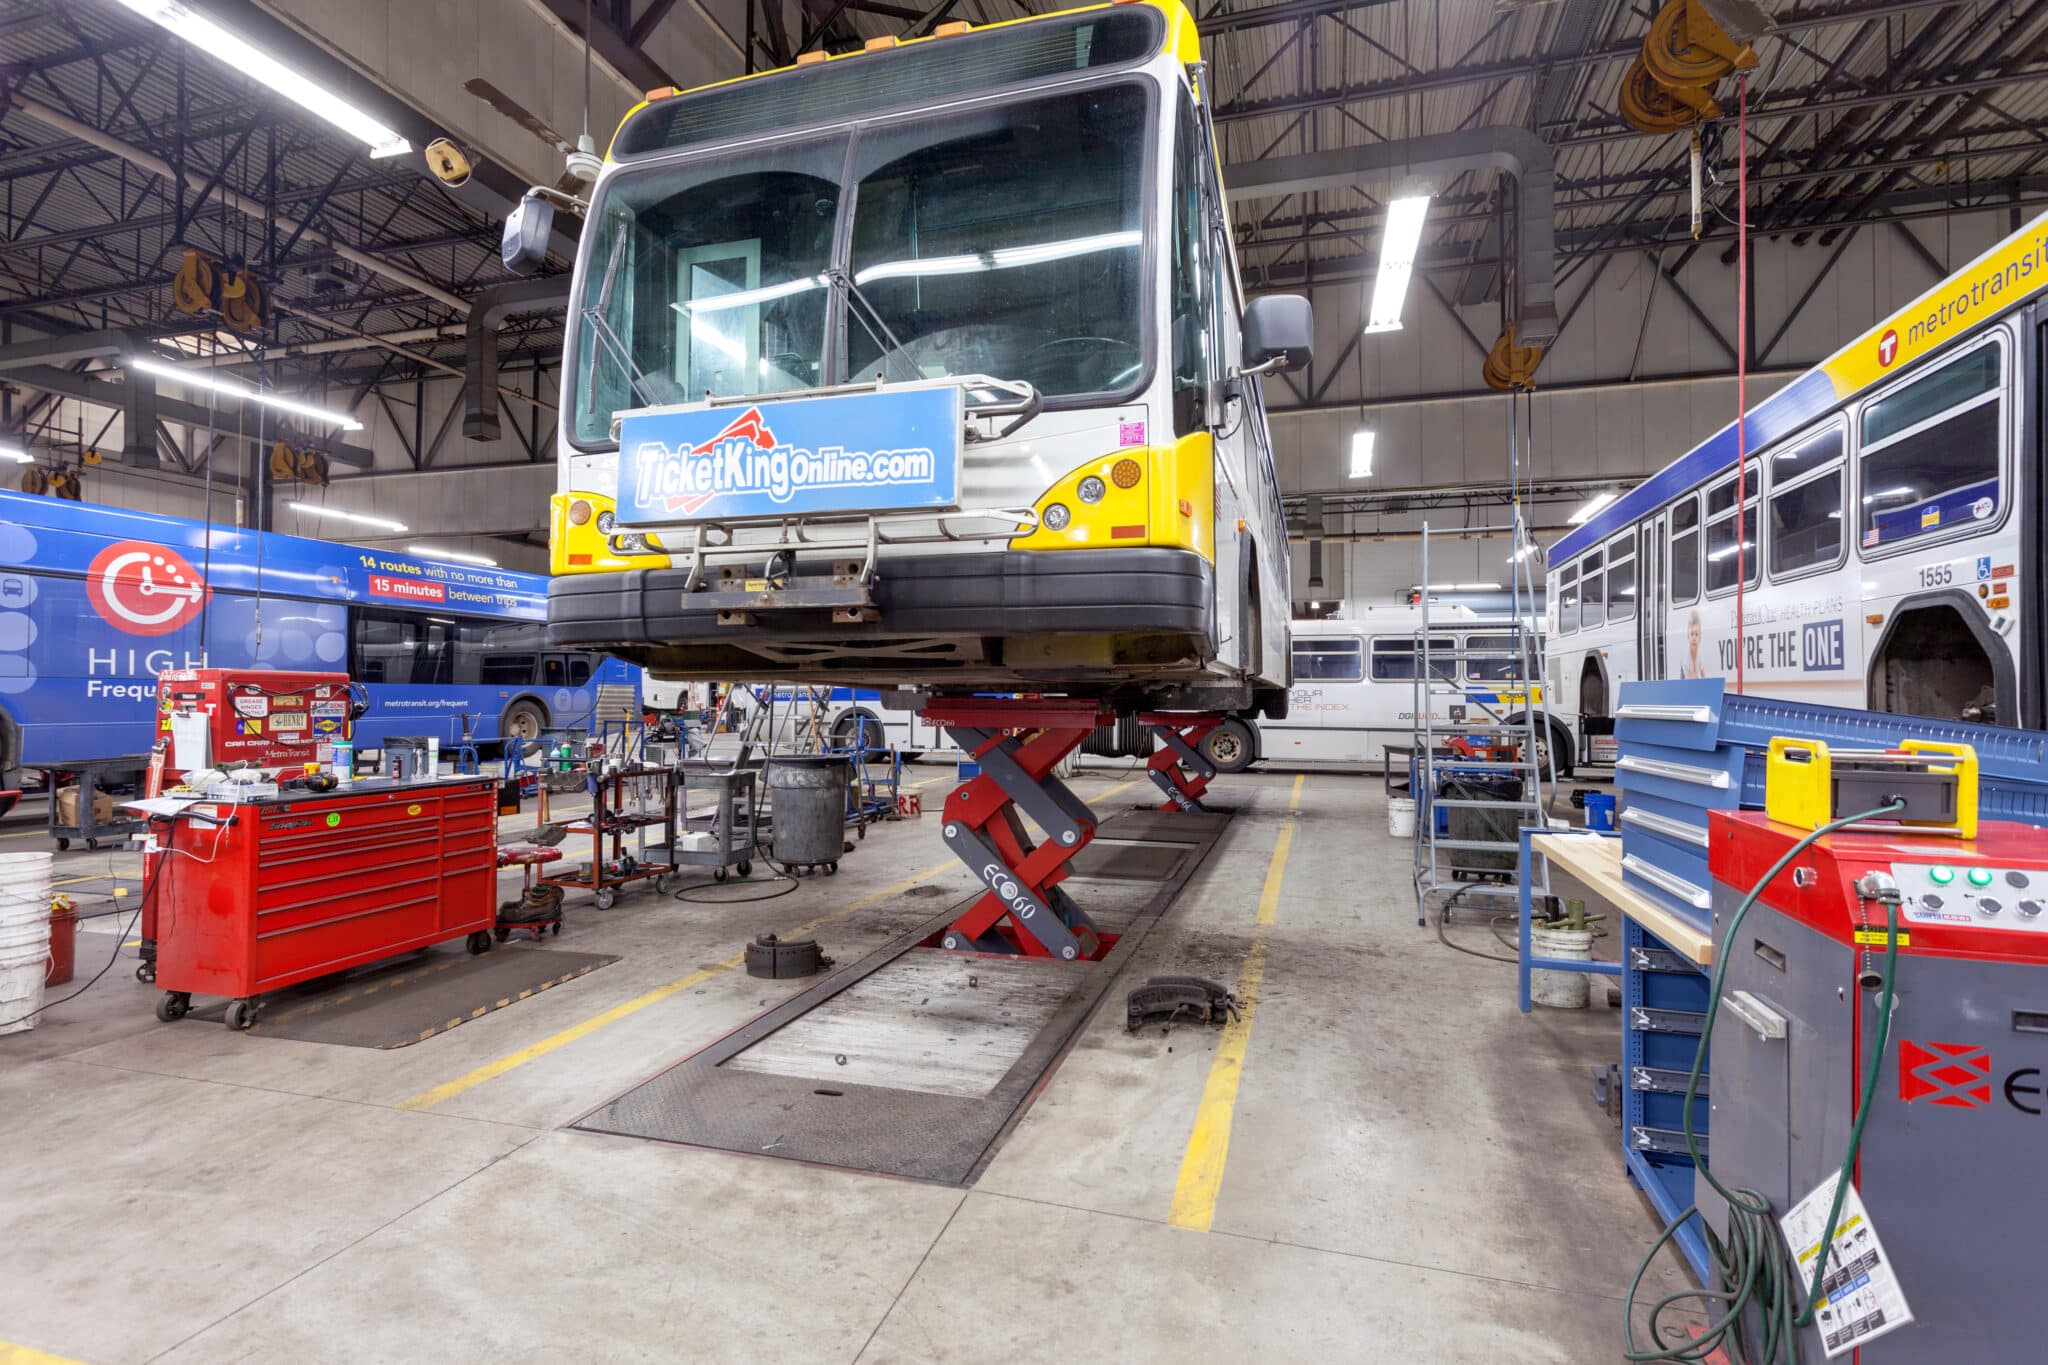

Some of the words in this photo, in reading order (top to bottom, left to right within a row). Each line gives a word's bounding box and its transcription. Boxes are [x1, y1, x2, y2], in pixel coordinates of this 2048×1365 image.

[1908, 237, 2048, 345] metrotransit
[636, 439, 933, 506] TicketKingOnline.com
[359, 555, 376, 568] 14
[380, 561, 422, 575] routes
[424, 566, 448, 579] with
[451, 571, 465, 581] no
[467, 575, 494, 585] more
[496, 576, 518, 589] than
[1919, 564, 1952, 588] 1555
[374, 579, 390, 592] 15
[394, 583, 443, 598] minutes
[448, 587, 494, 604] between
[496, 594, 518, 608] trips
[1768, 630, 1797, 668] THE
[1805, 624, 1842, 667] ONE
[88, 648, 208, 676] HIGH
[385, 699, 469, 708] metrotransit.org/frequent
[283, 714, 305, 727] HENRY
[265, 750, 287, 758] Metro
[288, 749, 311, 757] Transit
[983, 864, 1036, 919] ECO60
